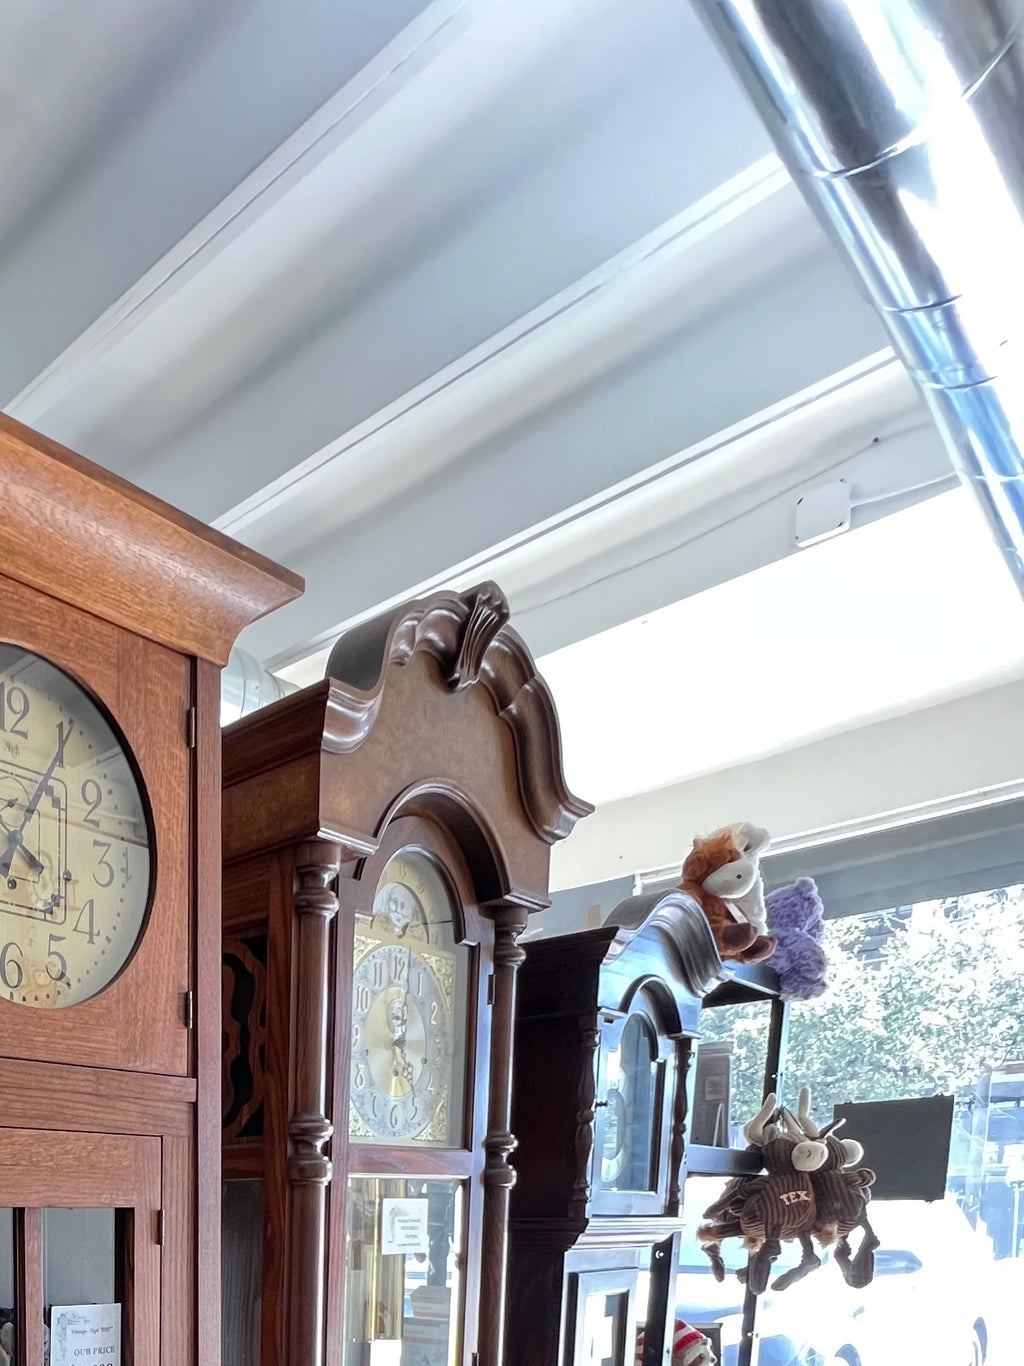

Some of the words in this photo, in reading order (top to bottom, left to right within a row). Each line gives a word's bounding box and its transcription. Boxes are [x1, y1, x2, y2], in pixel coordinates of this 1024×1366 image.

[81, 778, 103, 828] 2
[92, 839, 115, 888] 3
[72, 898, 101, 945] 4
[0, 941, 23, 989] 6
[45, 933, 67, 981] 5
[394, 955, 406, 981] 12
[356, 985, 369, 1012] 10
[431, 1002, 438, 1025] 2
[390, 1103, 399, 1130] 6
[779, 1190, 812, 1206] TEX
[74, 1347, 91, 1357] OUR
[93, 1345, 115, 1356] PRICE
